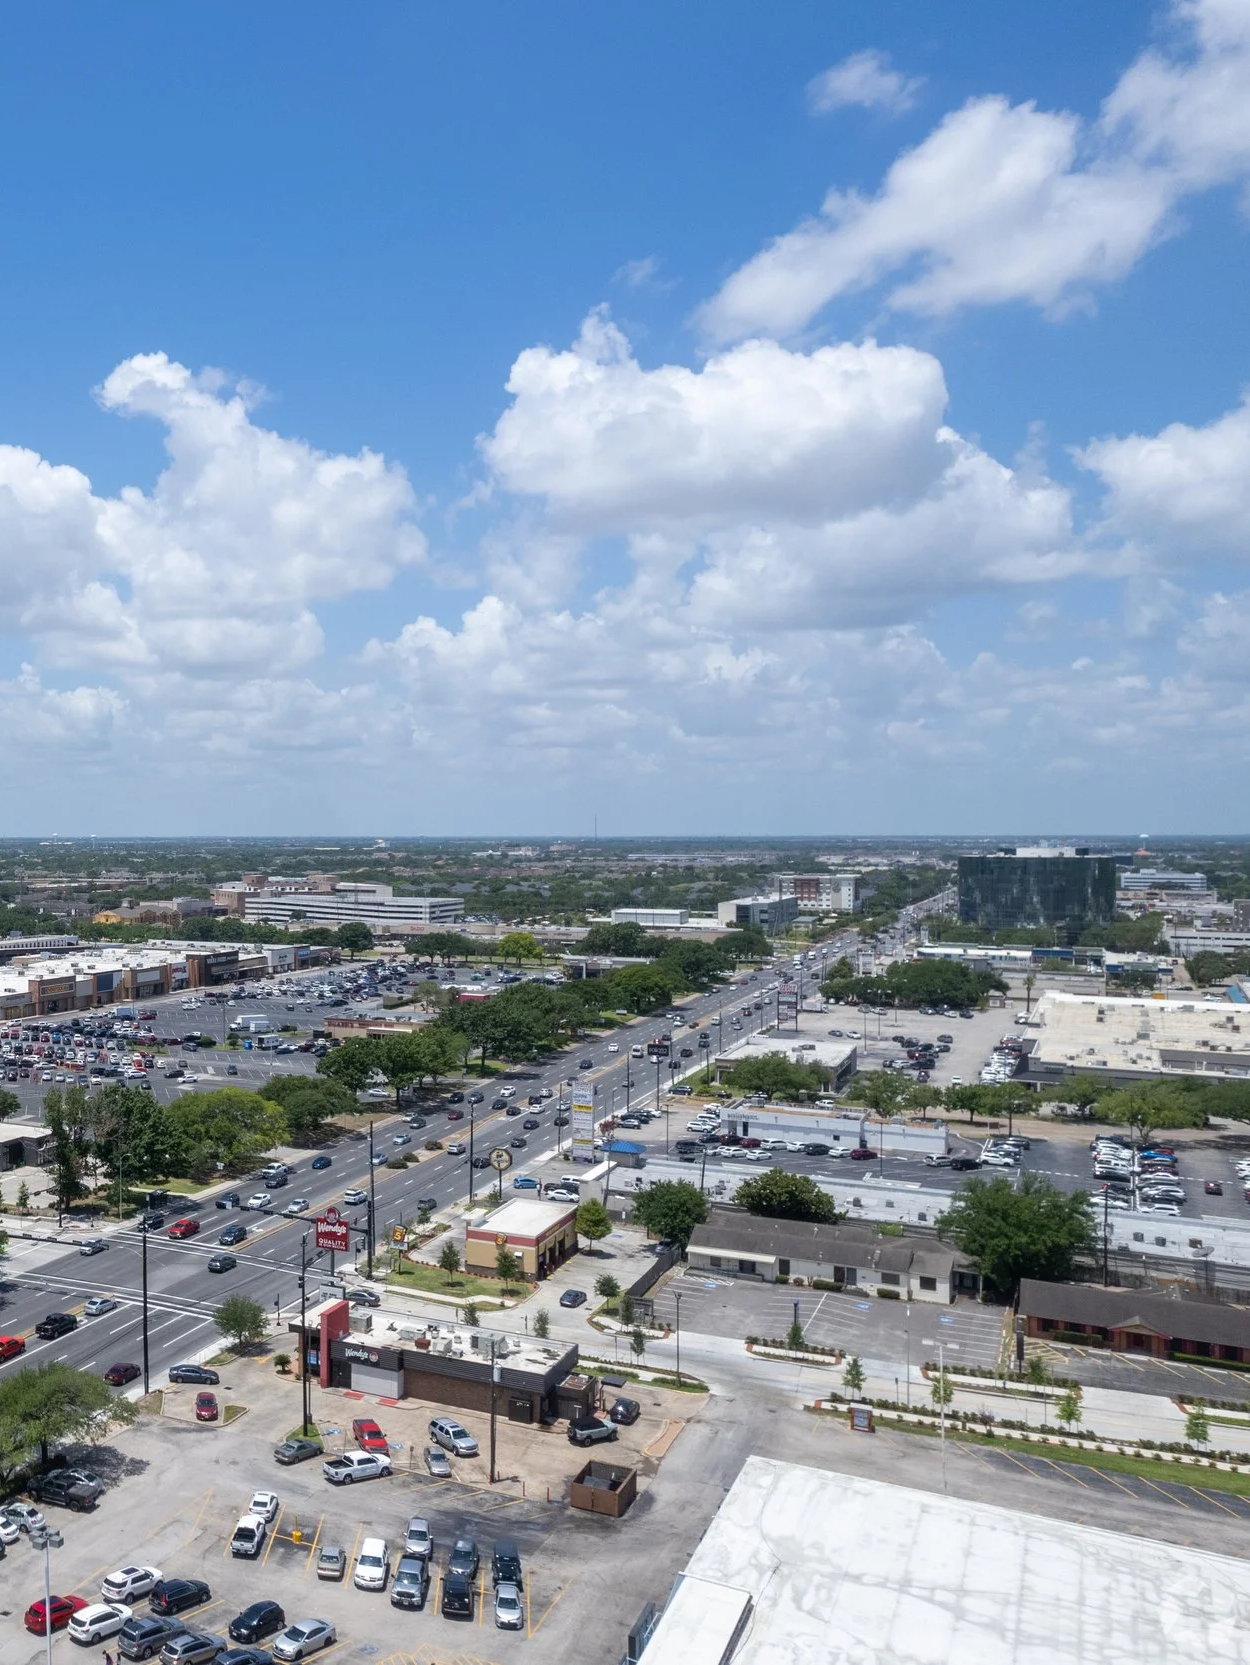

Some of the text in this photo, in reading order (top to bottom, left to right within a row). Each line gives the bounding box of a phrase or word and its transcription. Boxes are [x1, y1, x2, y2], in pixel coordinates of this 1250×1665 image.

[317, 1221, 347, 1236] Wendy's
[394, 1231, 402, 1240] 5
[318, 1237, 346, 1247] QUALITY
[345, 1348, 368, 1360] Wendy's
